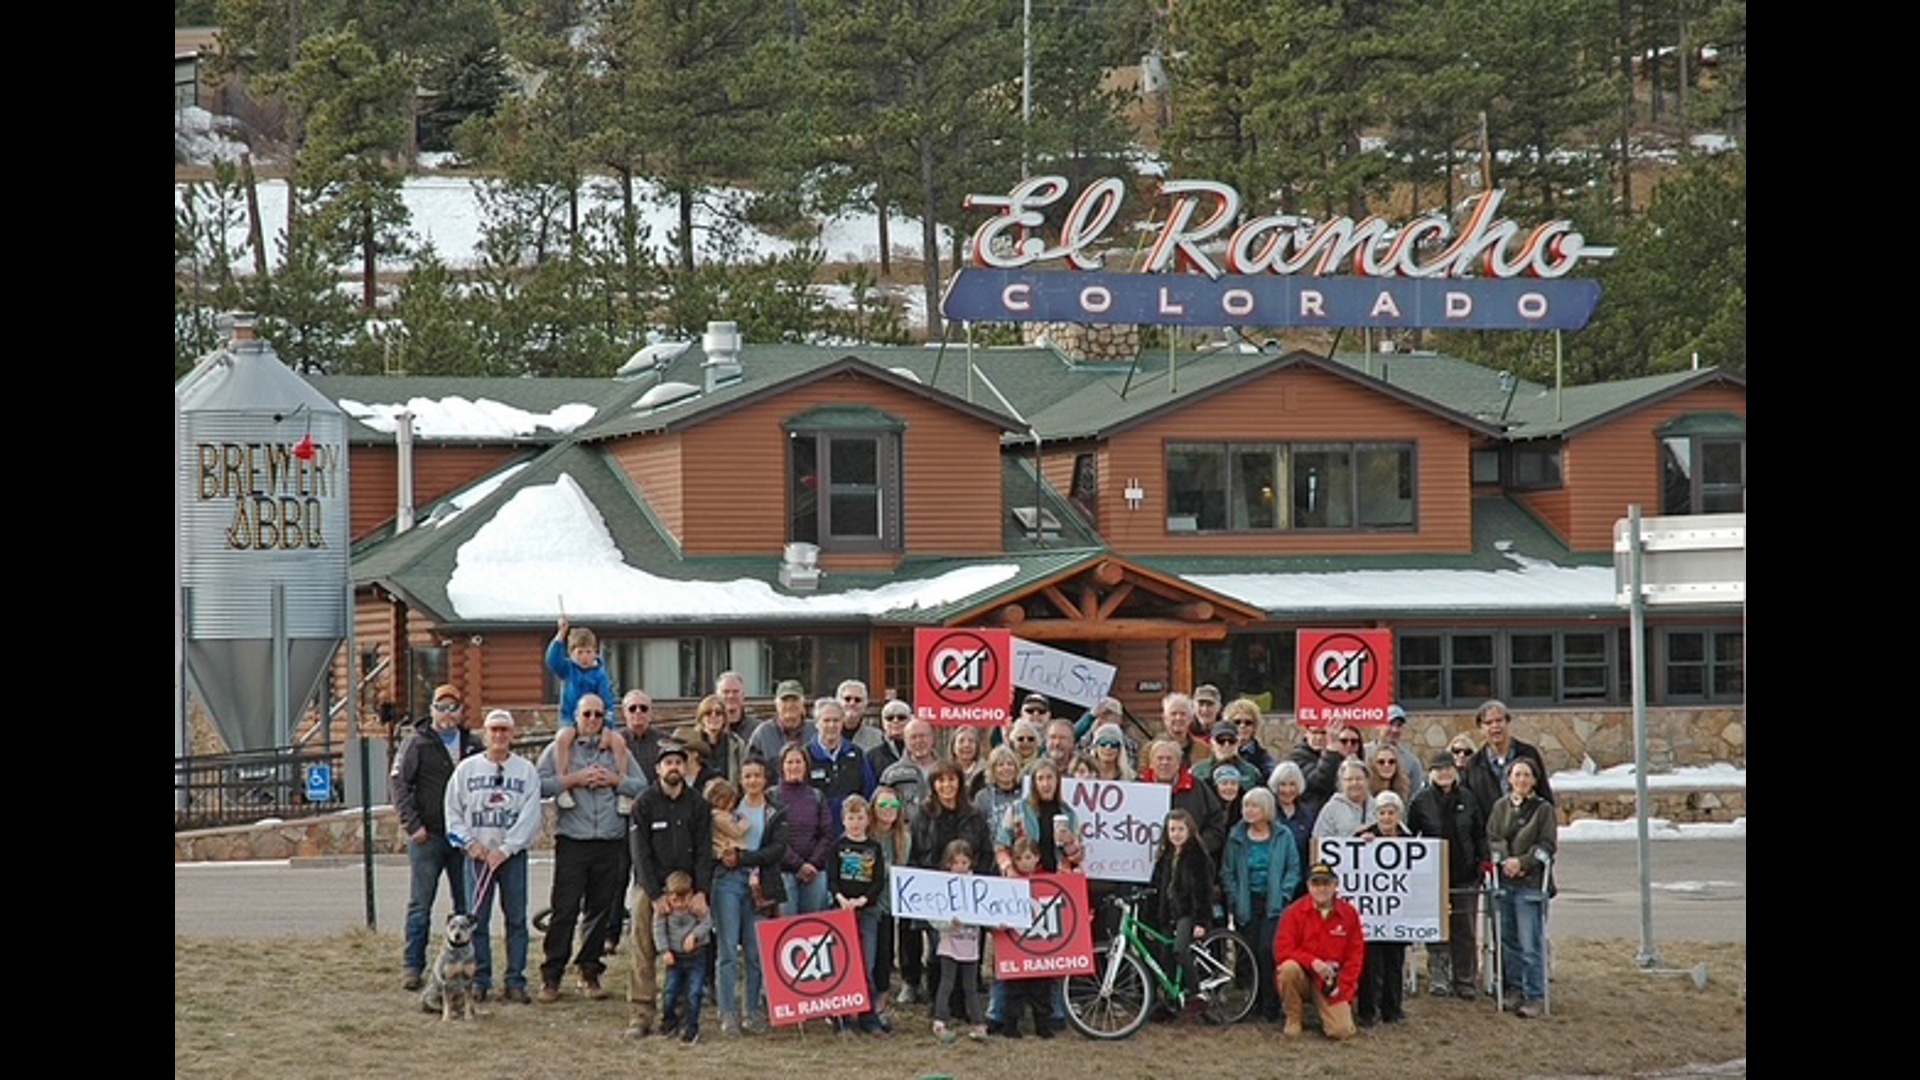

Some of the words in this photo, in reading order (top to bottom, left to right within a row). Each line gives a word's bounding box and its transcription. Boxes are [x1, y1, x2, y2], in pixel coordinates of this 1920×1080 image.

[964, 176, 1124, 270] El
[1142, 180, 1616, 280] Rancho
[1002, 284, 1549, 319] COLORADO
[197, 443, 340, 500] BREWERY
[918, 708, 936, 719] EL
[940, 707, 1006, 720] RANCHO
[1300, 708, 1318, 720] EL
[1321, 708, 1384, 720] RANCHO
[1072, 782, 1124, 812] NO
[1113, 815, 1162, 862] stop
[1321, 841, 1427, 870] STOP
[896, 876, 948, 916] Keep
[948, 877, 968, 912] El
[1343, 873, 1408, 893] UICK
[1000, 961, 1019, 973] EL
[1024, 956, 1089, 971] RANCHO
[774, 1004, 795, 1018] EL
[798, 993, 865, 1014] RANCHO
